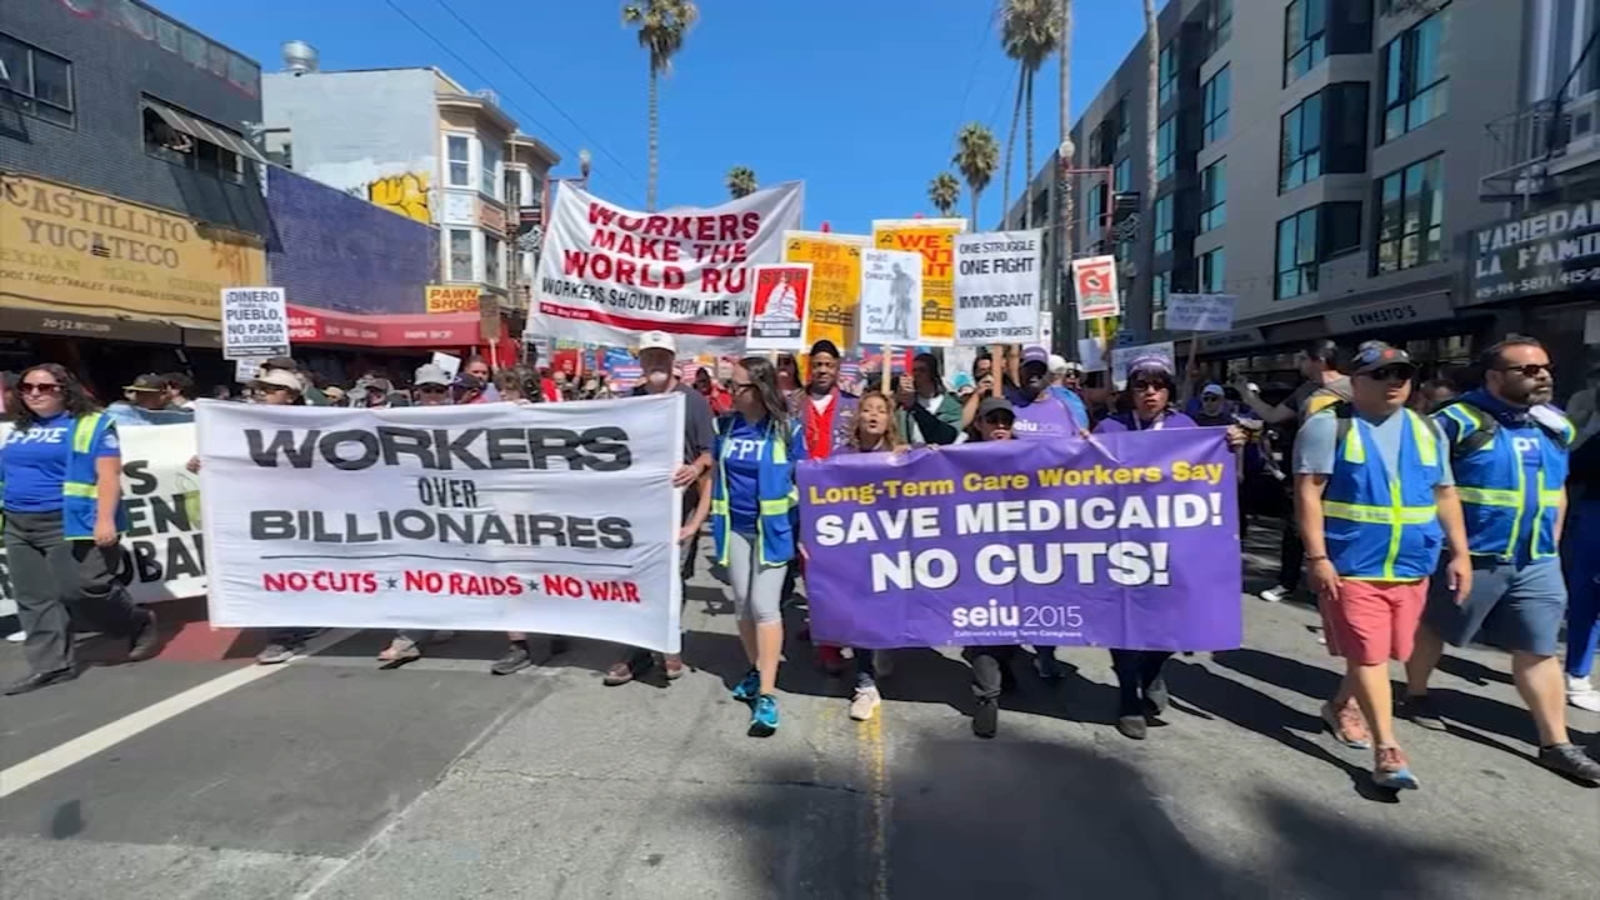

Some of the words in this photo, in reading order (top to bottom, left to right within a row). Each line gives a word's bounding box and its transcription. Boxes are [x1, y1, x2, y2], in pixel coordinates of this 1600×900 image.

[5, 181, 188, 243] CASTILLITO
[587, 202, 761, 240] WORKERS
[22, 217, 179, 269] YUCATECO
[591, 229, 681, 262] MAKE
[693, 243, 747, 264] THE
[897, 234, 941, 248] WE
[959, 243, 981, 254] ONE
[983, 240, 1035, 252] STRUGGLE
[564, 250, 687, 290] WORLD
[701, 267, 747, 293] RU
[959, 259, 990, 275] ONE
[993, 258, 1035, 273] FIGHT
[1475, 255, 1502, 278] LA
[430, 289, 478, 299] PAWN
[430, 299, 478, 310] SHOP
[541, 277, 605, 304] WORKERS
[609, 289, 664, 311] SHOULD
[669, 297, 700, 314] RUN
[703, 300, 730, 317] THE
[959, 293, 1034, 308] IMMIGRANT
[226, 308, 282, 321] PUEBLO,
[228, 324, 245, 335] NO
[248, 323, 283, 334] PARA
[984, 311, 1008, 323] AND
[1351, 304, 1417, 326] ERNESTO'S
[959, 327, 999, 338] WORKER
[1000, 326, 1034, 337] RIGHTS
[1013, 420, 1038, 431] eiu
[244, 426, 633, 473] WORKERS
[418, 476, 477, 509] OVER
[809, 477, 956, 507] Long-Term
[963, 471, 1028, 493] Care
[1037, 463, 1163, 489] Workers
[1171, 459, 1224, 486] Say
[250, 509, 634, 550] BILLIONAIRES
[815, 506, 941, 547] SAVE
[956, 492, 1223, 536] MEDICAID!
[870, 548, 959, 593] NO
[975, 540, 1170, 587] CUTS!
[263, 571, 310, 593] NO
[311, 571, 378, 594] CUTS
[404, 570, 446, 594] NO
[449, 574, 523, 598] RAIDS
[543, 574, 585, 599] NO
[588, 579, 640, 604] WAR
[952, 598, 1020, 628] seiu
[1023, 605, 1084, 628] 2015
